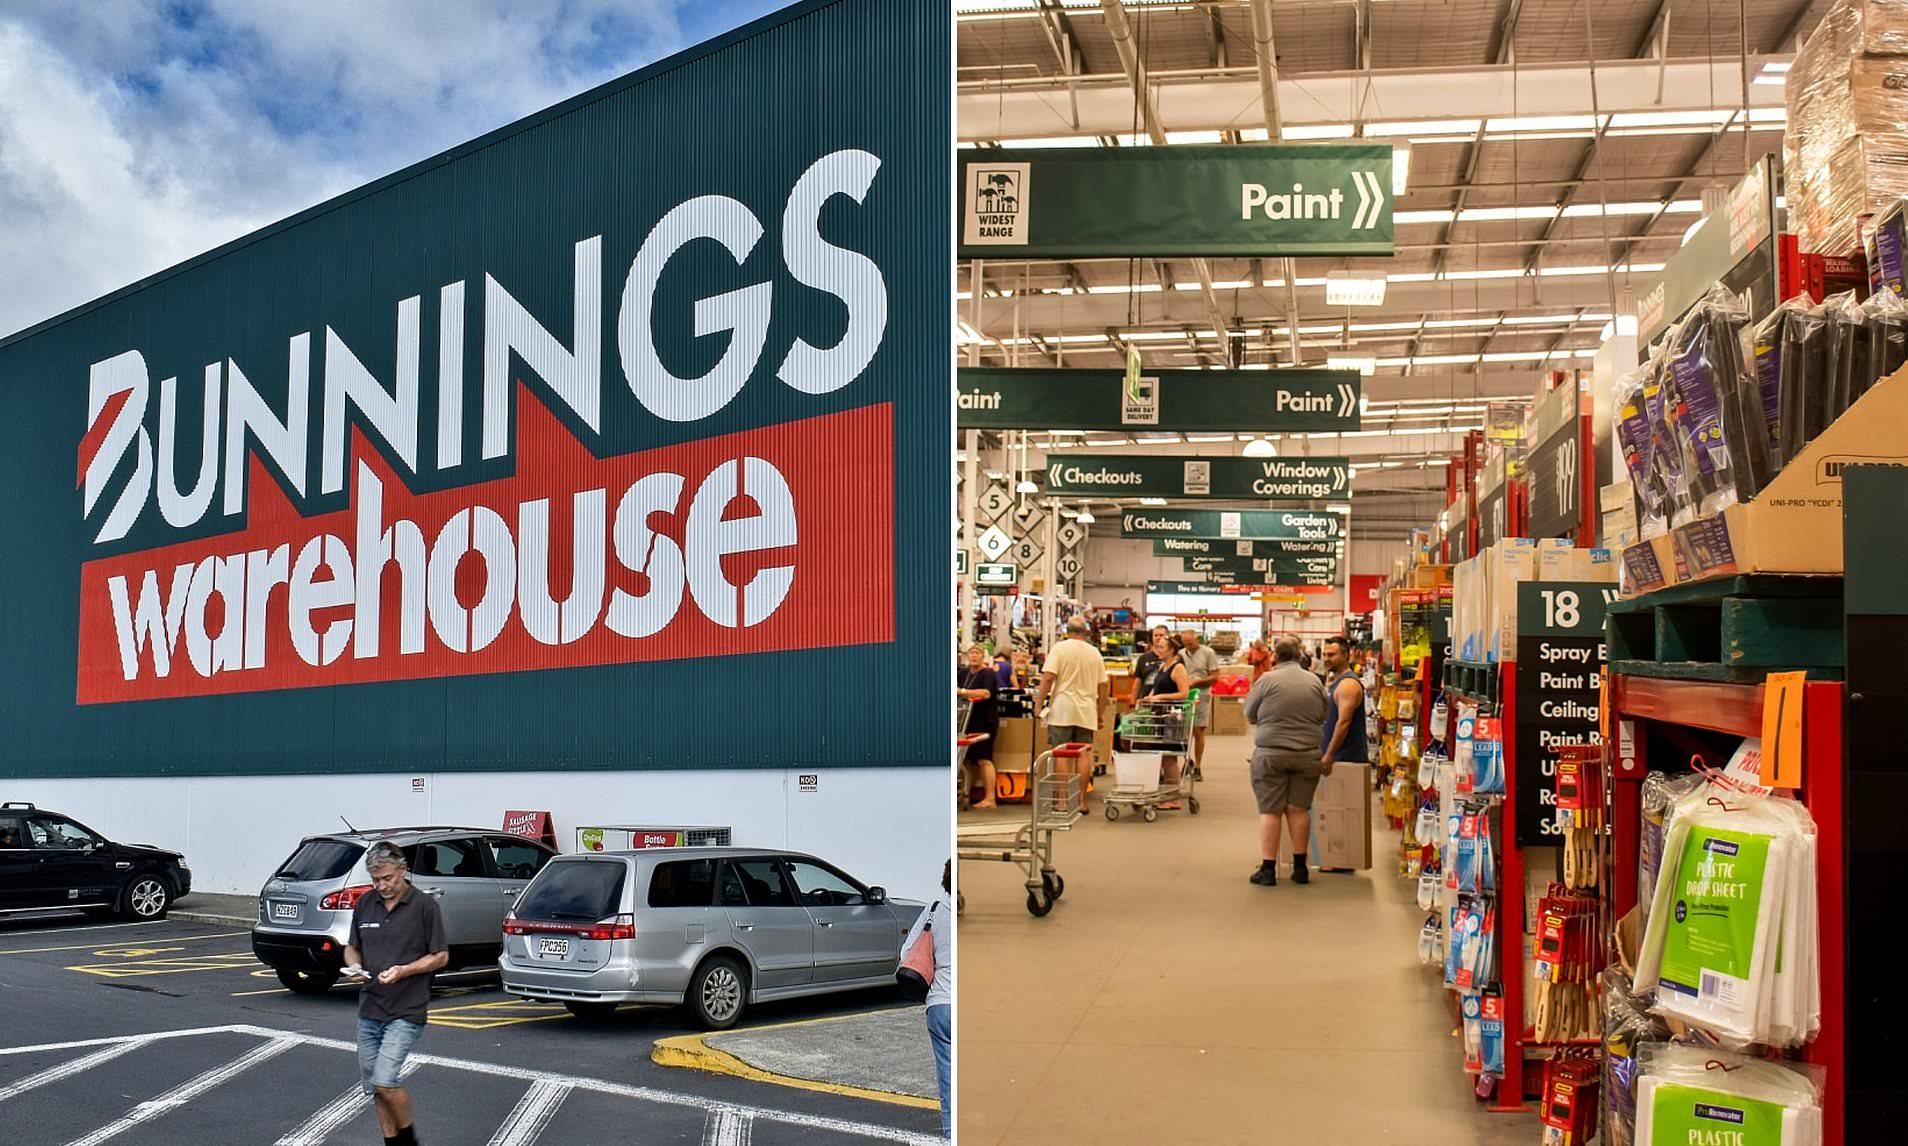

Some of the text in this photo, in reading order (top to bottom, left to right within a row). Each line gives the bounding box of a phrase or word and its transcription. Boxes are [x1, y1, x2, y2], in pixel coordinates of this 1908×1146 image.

[1242, 183, 1343, 220] Paint
[979, 215, 1015, 225] WIDEST
[980, 227, 1013, 237] RANGE
[83, 148, 889, 545] BUNNINGS
[1276, 389, 1333, 412] Paint
[1064, 467, 1143, 485] Checkouts
[1262, 462, 1330, 478] Window
[1253, 480, 1331, 496] Coverings
[988, 494, 999, 510] 5
[1770, 498, 1806, 507] UNI-PRO
[1134, 518, 1192, 531] Checkouts
[1282, 513, 1327, 527] Garden
[1064, 529, 1075, 543] 9
[1298, 526, 1327, 539] Tools
[987, 534, 999, 550] 6
[1164, 539, 1209, 552] Watering
[1281, 541, 1326, 553] Watering
[1020, 544, 1031, 559] 8
[107, 455, 799, 682] warehouse
[1062, 560, 1078, 573] 10
[1192, 561, 1212, 570] Care
[1308, 562, 1328, 572] Care
[1541, 590, 1580, 628] 18
[1540, 643, 1591, 663] Spray
[1540, 672, 1584, 689] Paint
[1540, 701, 1599, 721] Ceiling
[1478, 719, 1488, 733] 5
[1540, 731, 1583, 747] Paint
[508, 812, 537, 826] SAUSAGE
[644, 835, 666, 844] Bottle
[1686, 881, 1747, 899] DROP SHEET
[1486, 998, 1496, 1014] 5
[1482, 1023, 1500, 1031] LEAD
[1688, 1129, 1744, 1146] PLASTIC
